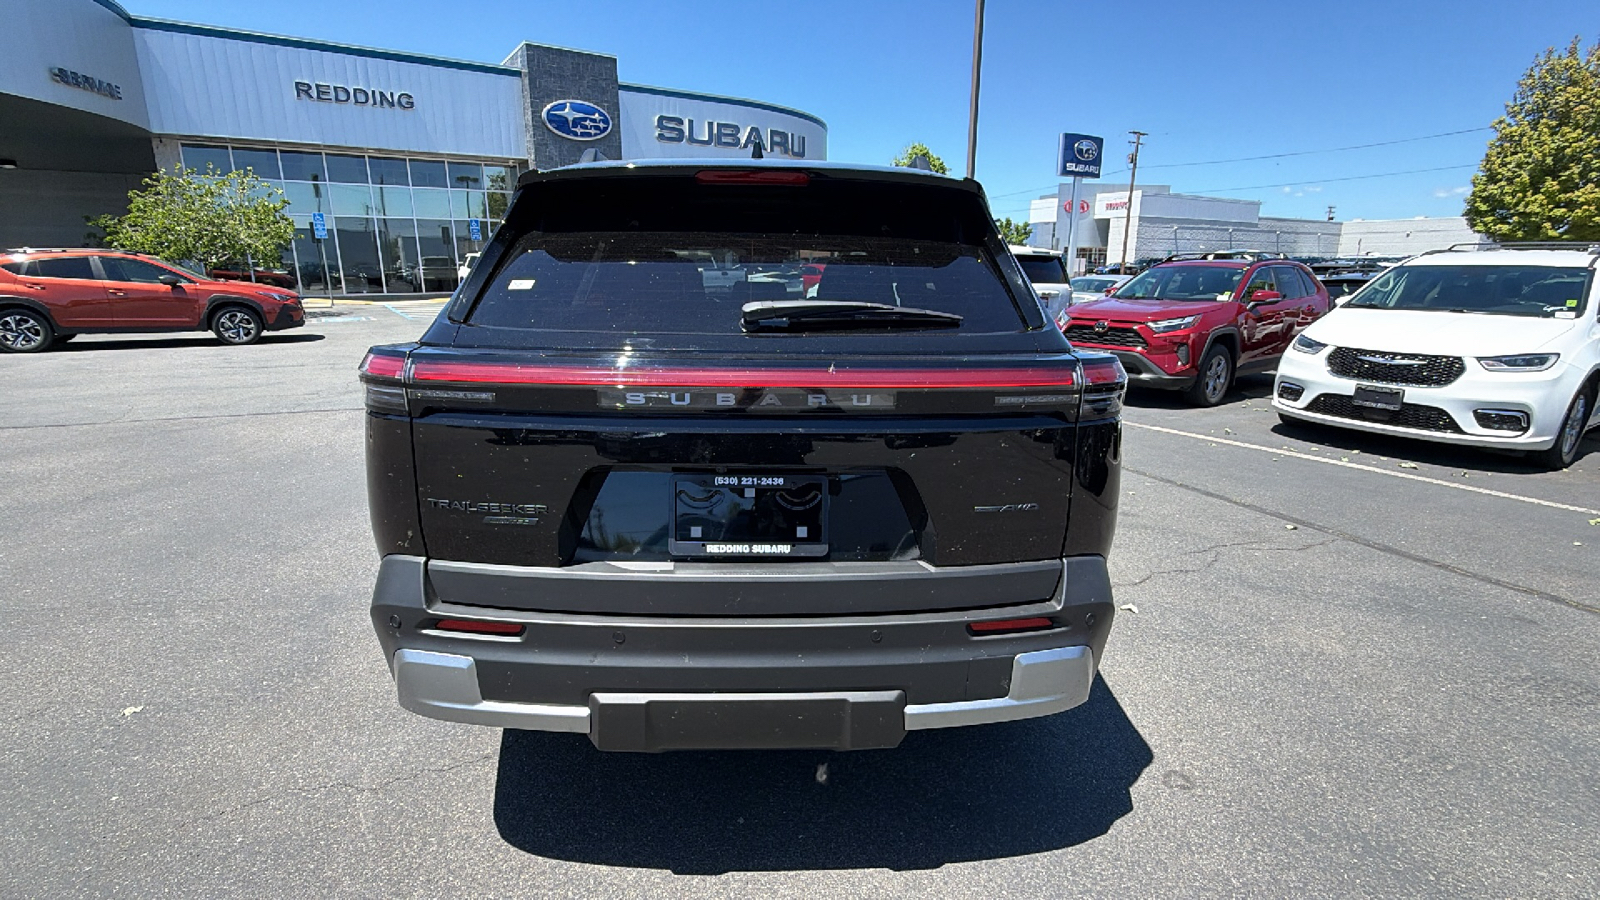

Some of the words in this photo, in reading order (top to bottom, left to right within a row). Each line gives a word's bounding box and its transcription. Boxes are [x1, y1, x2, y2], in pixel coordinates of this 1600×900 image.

[294, 80, 415, 110] REDDING
[656, 115, 805, 158] SUBARU
[1066, 162, 1100, 174] SUBARU
[625, 391, 872, 406] SUBARU
[714, 476, 738, 486] (530)
[427, 497, 549, 514] TRAILSEEKER
[706, 544, 750, 554] REDDING
[751, 544, 791, 554] SUBARU
